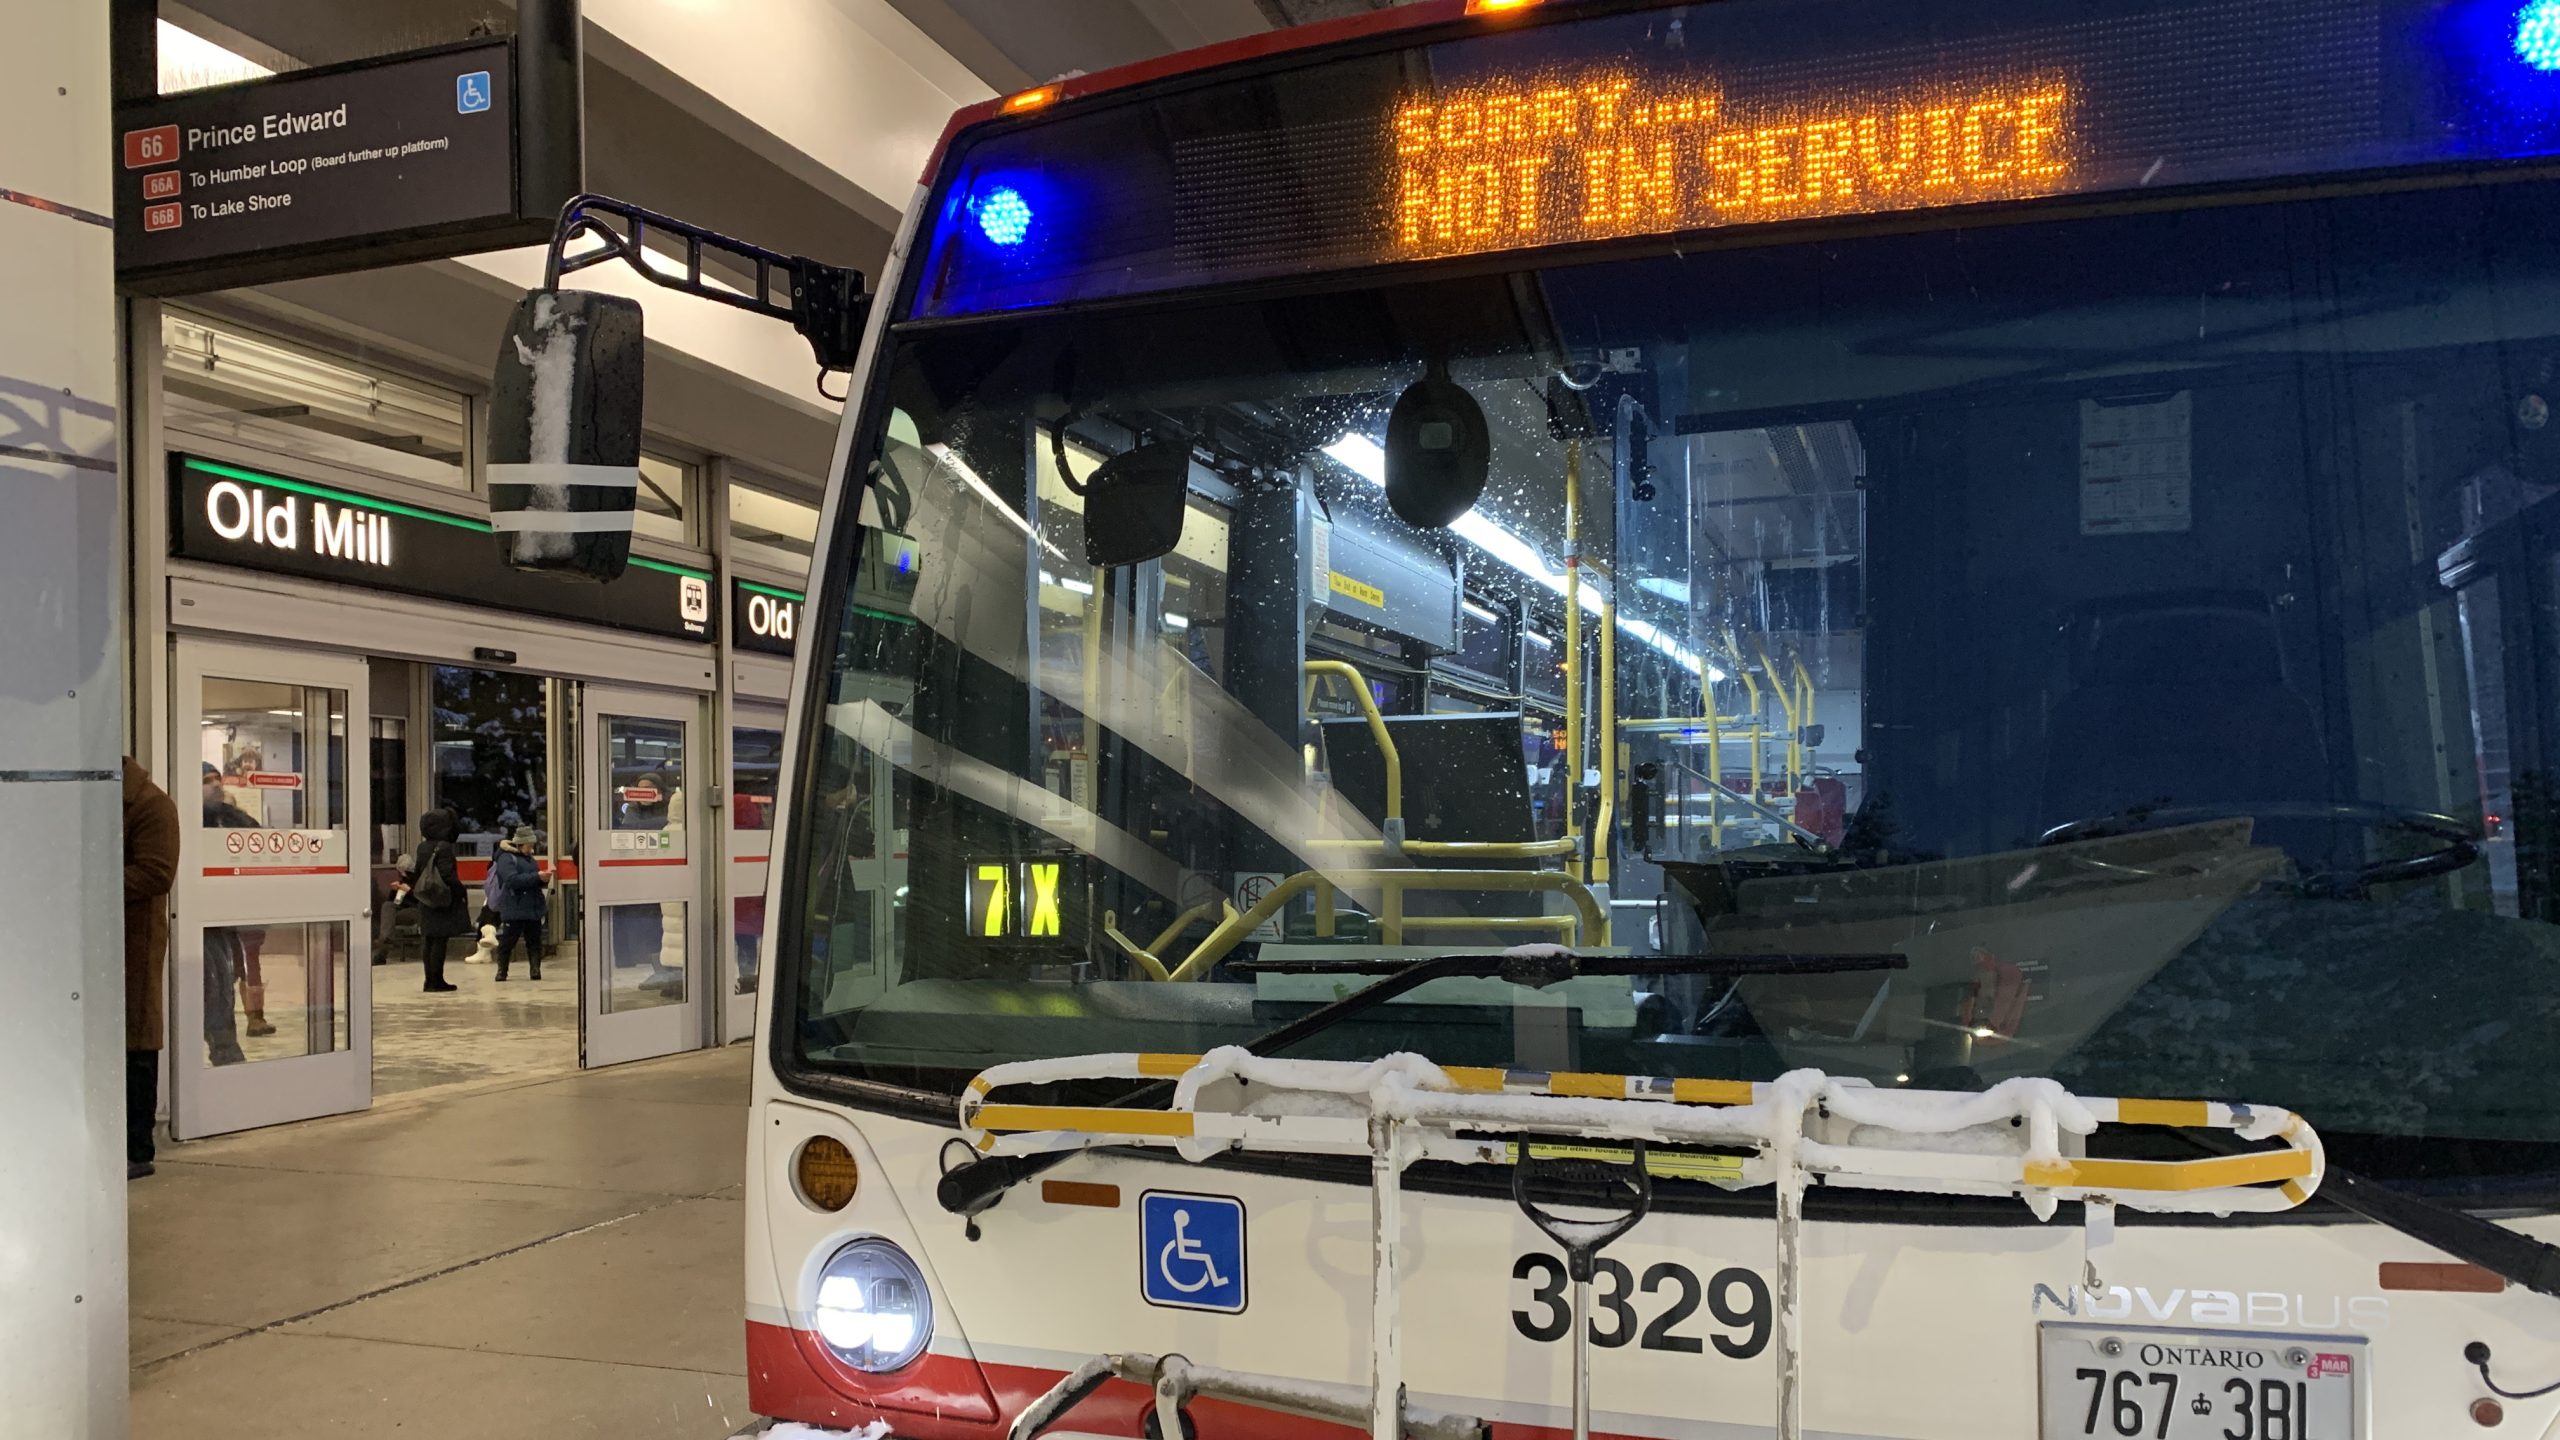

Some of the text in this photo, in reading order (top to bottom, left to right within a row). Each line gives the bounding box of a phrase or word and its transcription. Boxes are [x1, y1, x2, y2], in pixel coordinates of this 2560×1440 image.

[141, 135, 163, 158] 66
[187, 103, 347, 151] Prince Edward
[151, 177, 174, 193] 66A
[189, 136, 449, 188] To Humber Loop (Board further up platform)
[1402, 95, 2066, 242] NOT IN SERVICE
[152, 209, 175, 226] 66B
[190, 193, 292, 219] To Lake Shore
[206, 481, 391, 567] Old Mill
[748, 594, 793, 640] Old
[1511, 1252, 1773, 1360] 3329
[2140, 1343, 2264, 1372] ONTARIO
[2321, 1359, 2349, 1372] MAR
[2076, 1367, 2179, 1440] 767
